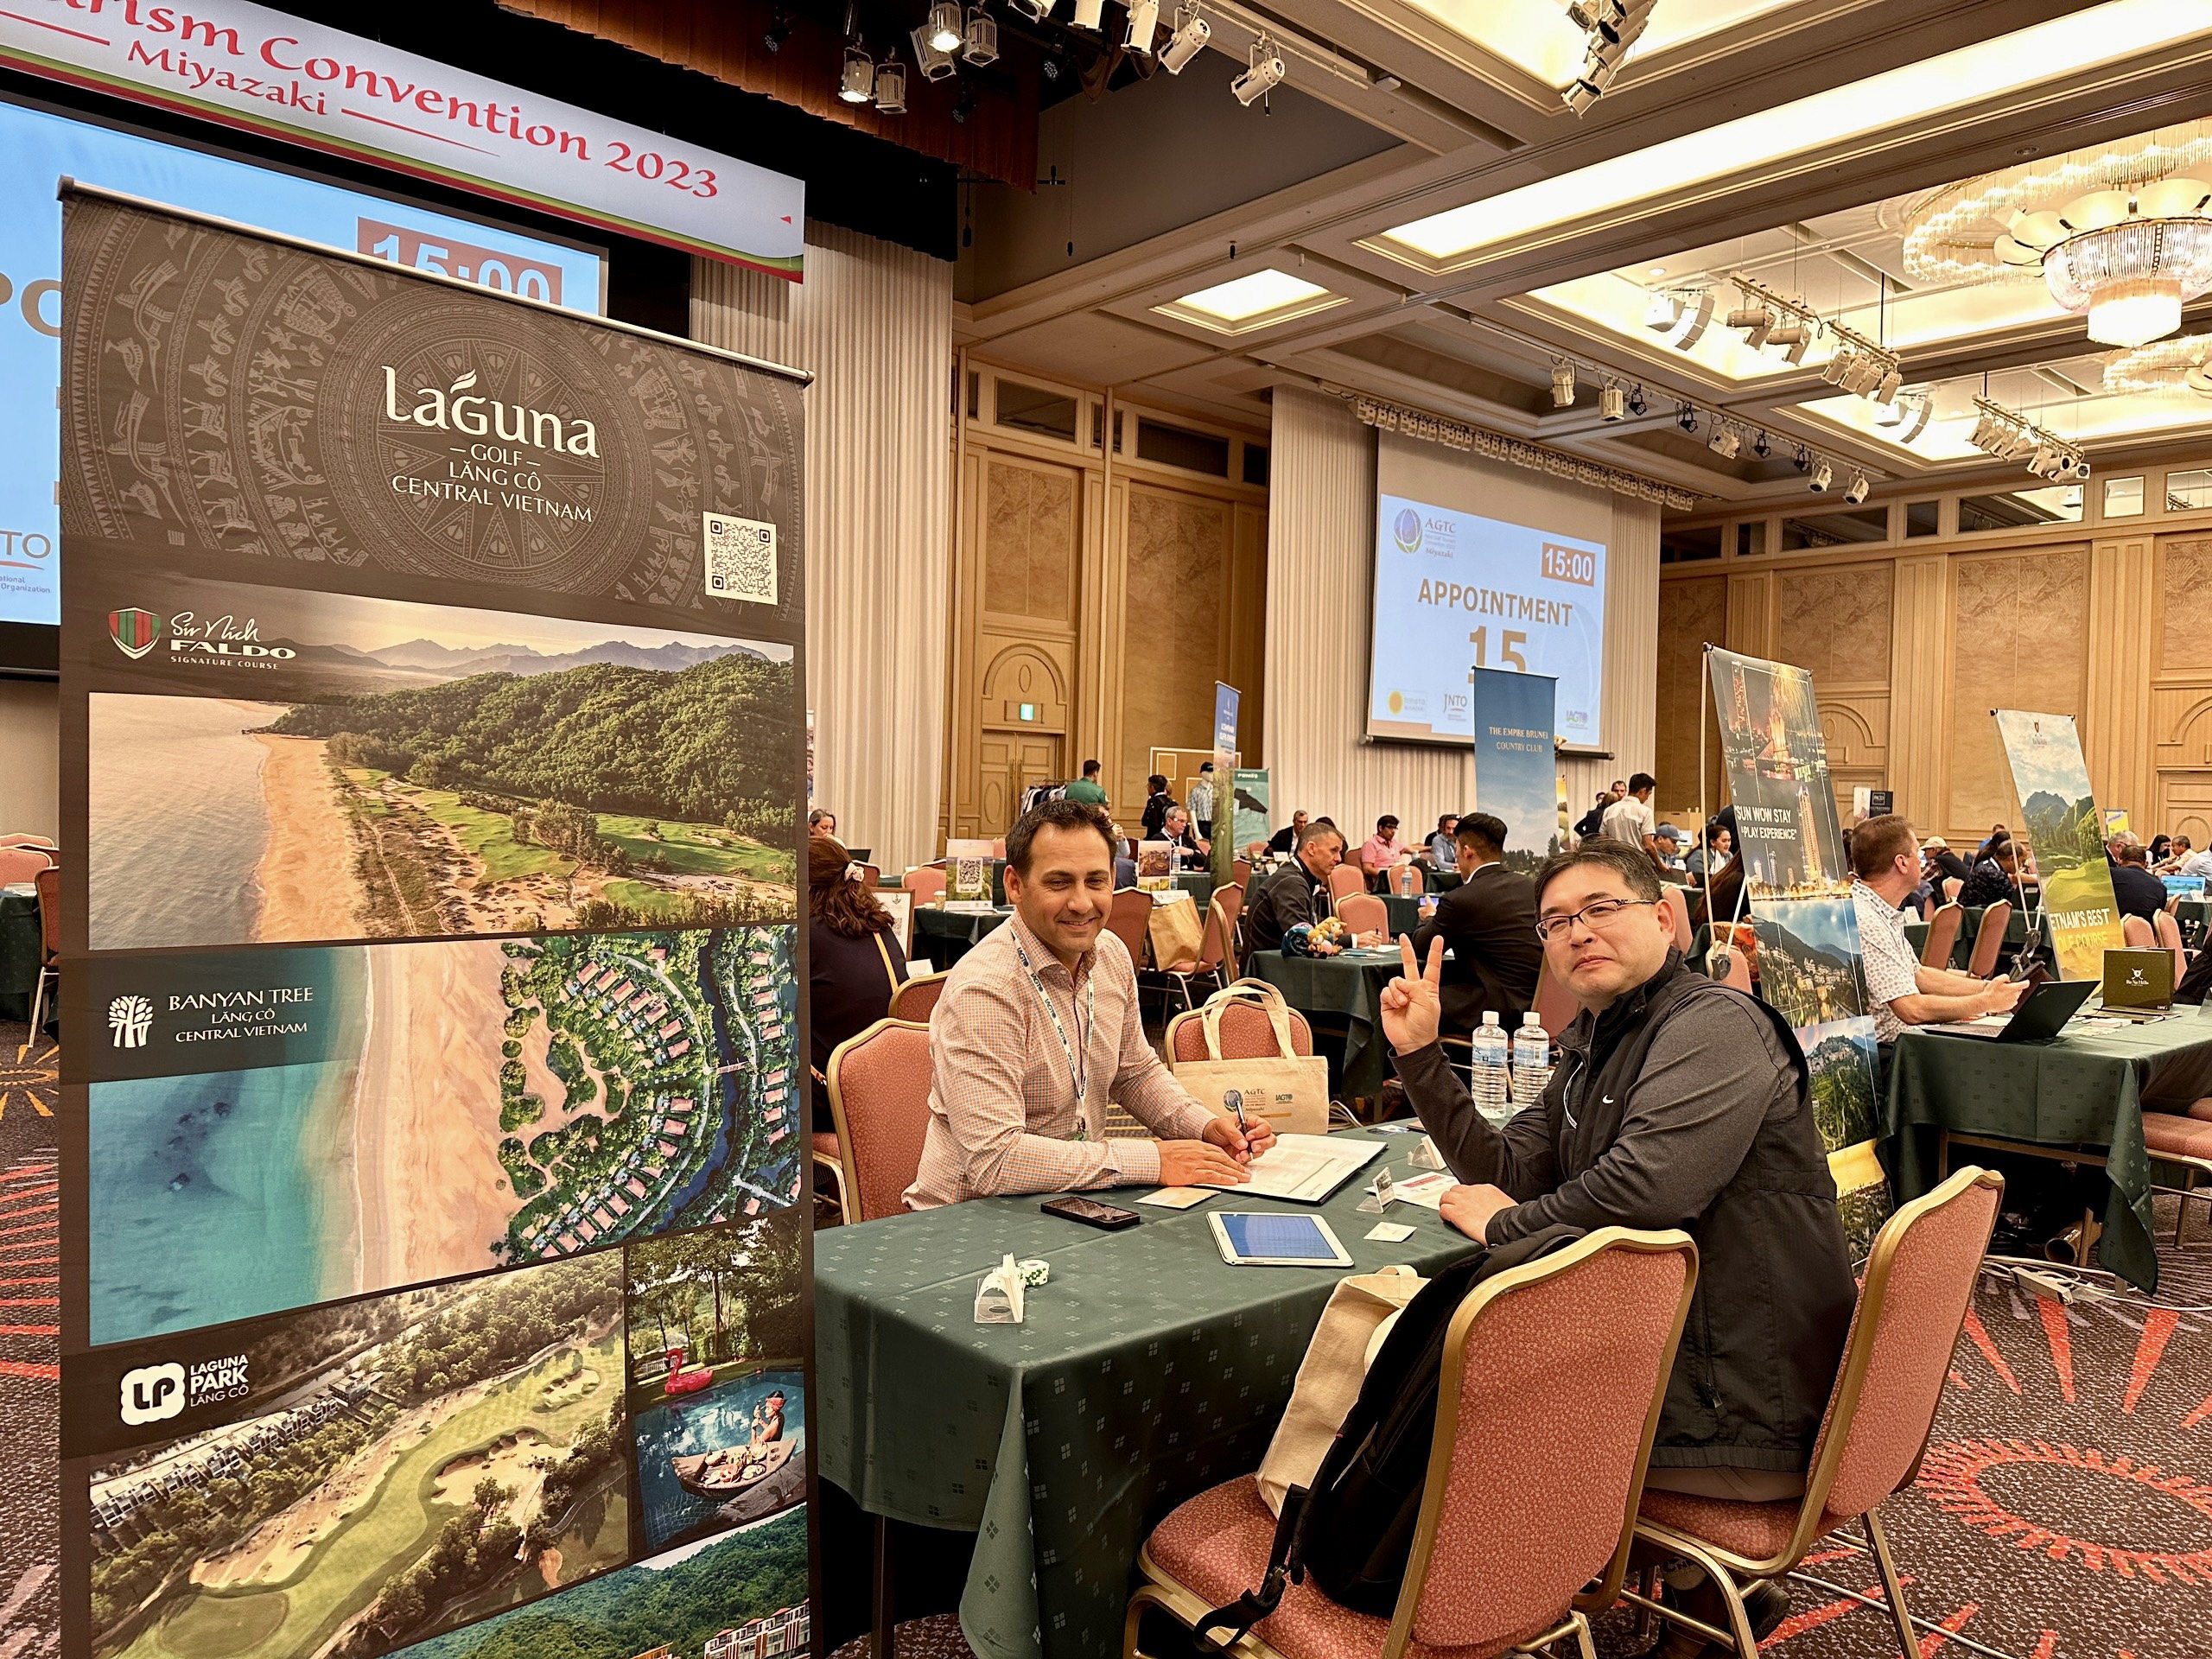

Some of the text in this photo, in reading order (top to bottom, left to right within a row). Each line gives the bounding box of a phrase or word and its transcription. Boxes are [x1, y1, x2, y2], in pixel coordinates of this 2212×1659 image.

[127, 40, 328, 116] Miyazaki
[258, 36, 591, 161] Convention
[604, 141, 719, 199] 2023
[470, 443, 523, 467] GOLF
[448, 460, 542, 493] LĂNG CÔ
[391, 474, 593, 523] CENTRAL VIETNAM
[1425, 518, 1456, 533] AGTC
[1545, 547, 1592, 582] 15:00
[1, 582, 51, 594] Organization
[1417, 578, 1573, 627] APPOINTMENT
[170, 611, 261, 643] Sir Nick
[170, 639, 297, 659] FALDO
[1468, 625, 1527, 684] 15
[170, 655, 279, 671] SIGNATURE COURSE
[1443, 693, 1468, 714] JNTO
[1489, 727, 1548, 740] THE EMPIRE BRUNEI
[1496, 741, 1542, 753] COUNTRY CLUB
[1752, 806, 1772, 823] WOW
[1773, 808, 1791, 823] STAY
[2086, 908, 2110, 927] BEST
[2075, 931, 2108, 948] COURSE
[168, 987, 314, 1011] BANYAN TREE
[211, 1007, 276, 1025] LĂNG CÔ
[175, 1022, 308, 1043] CENTRAL VIETNAM
[190, 1354, 249, 1376] LAGUNA
[190, 1364, 249, 1395] PARK
[227, 1383, 250, 1398] CÔ
